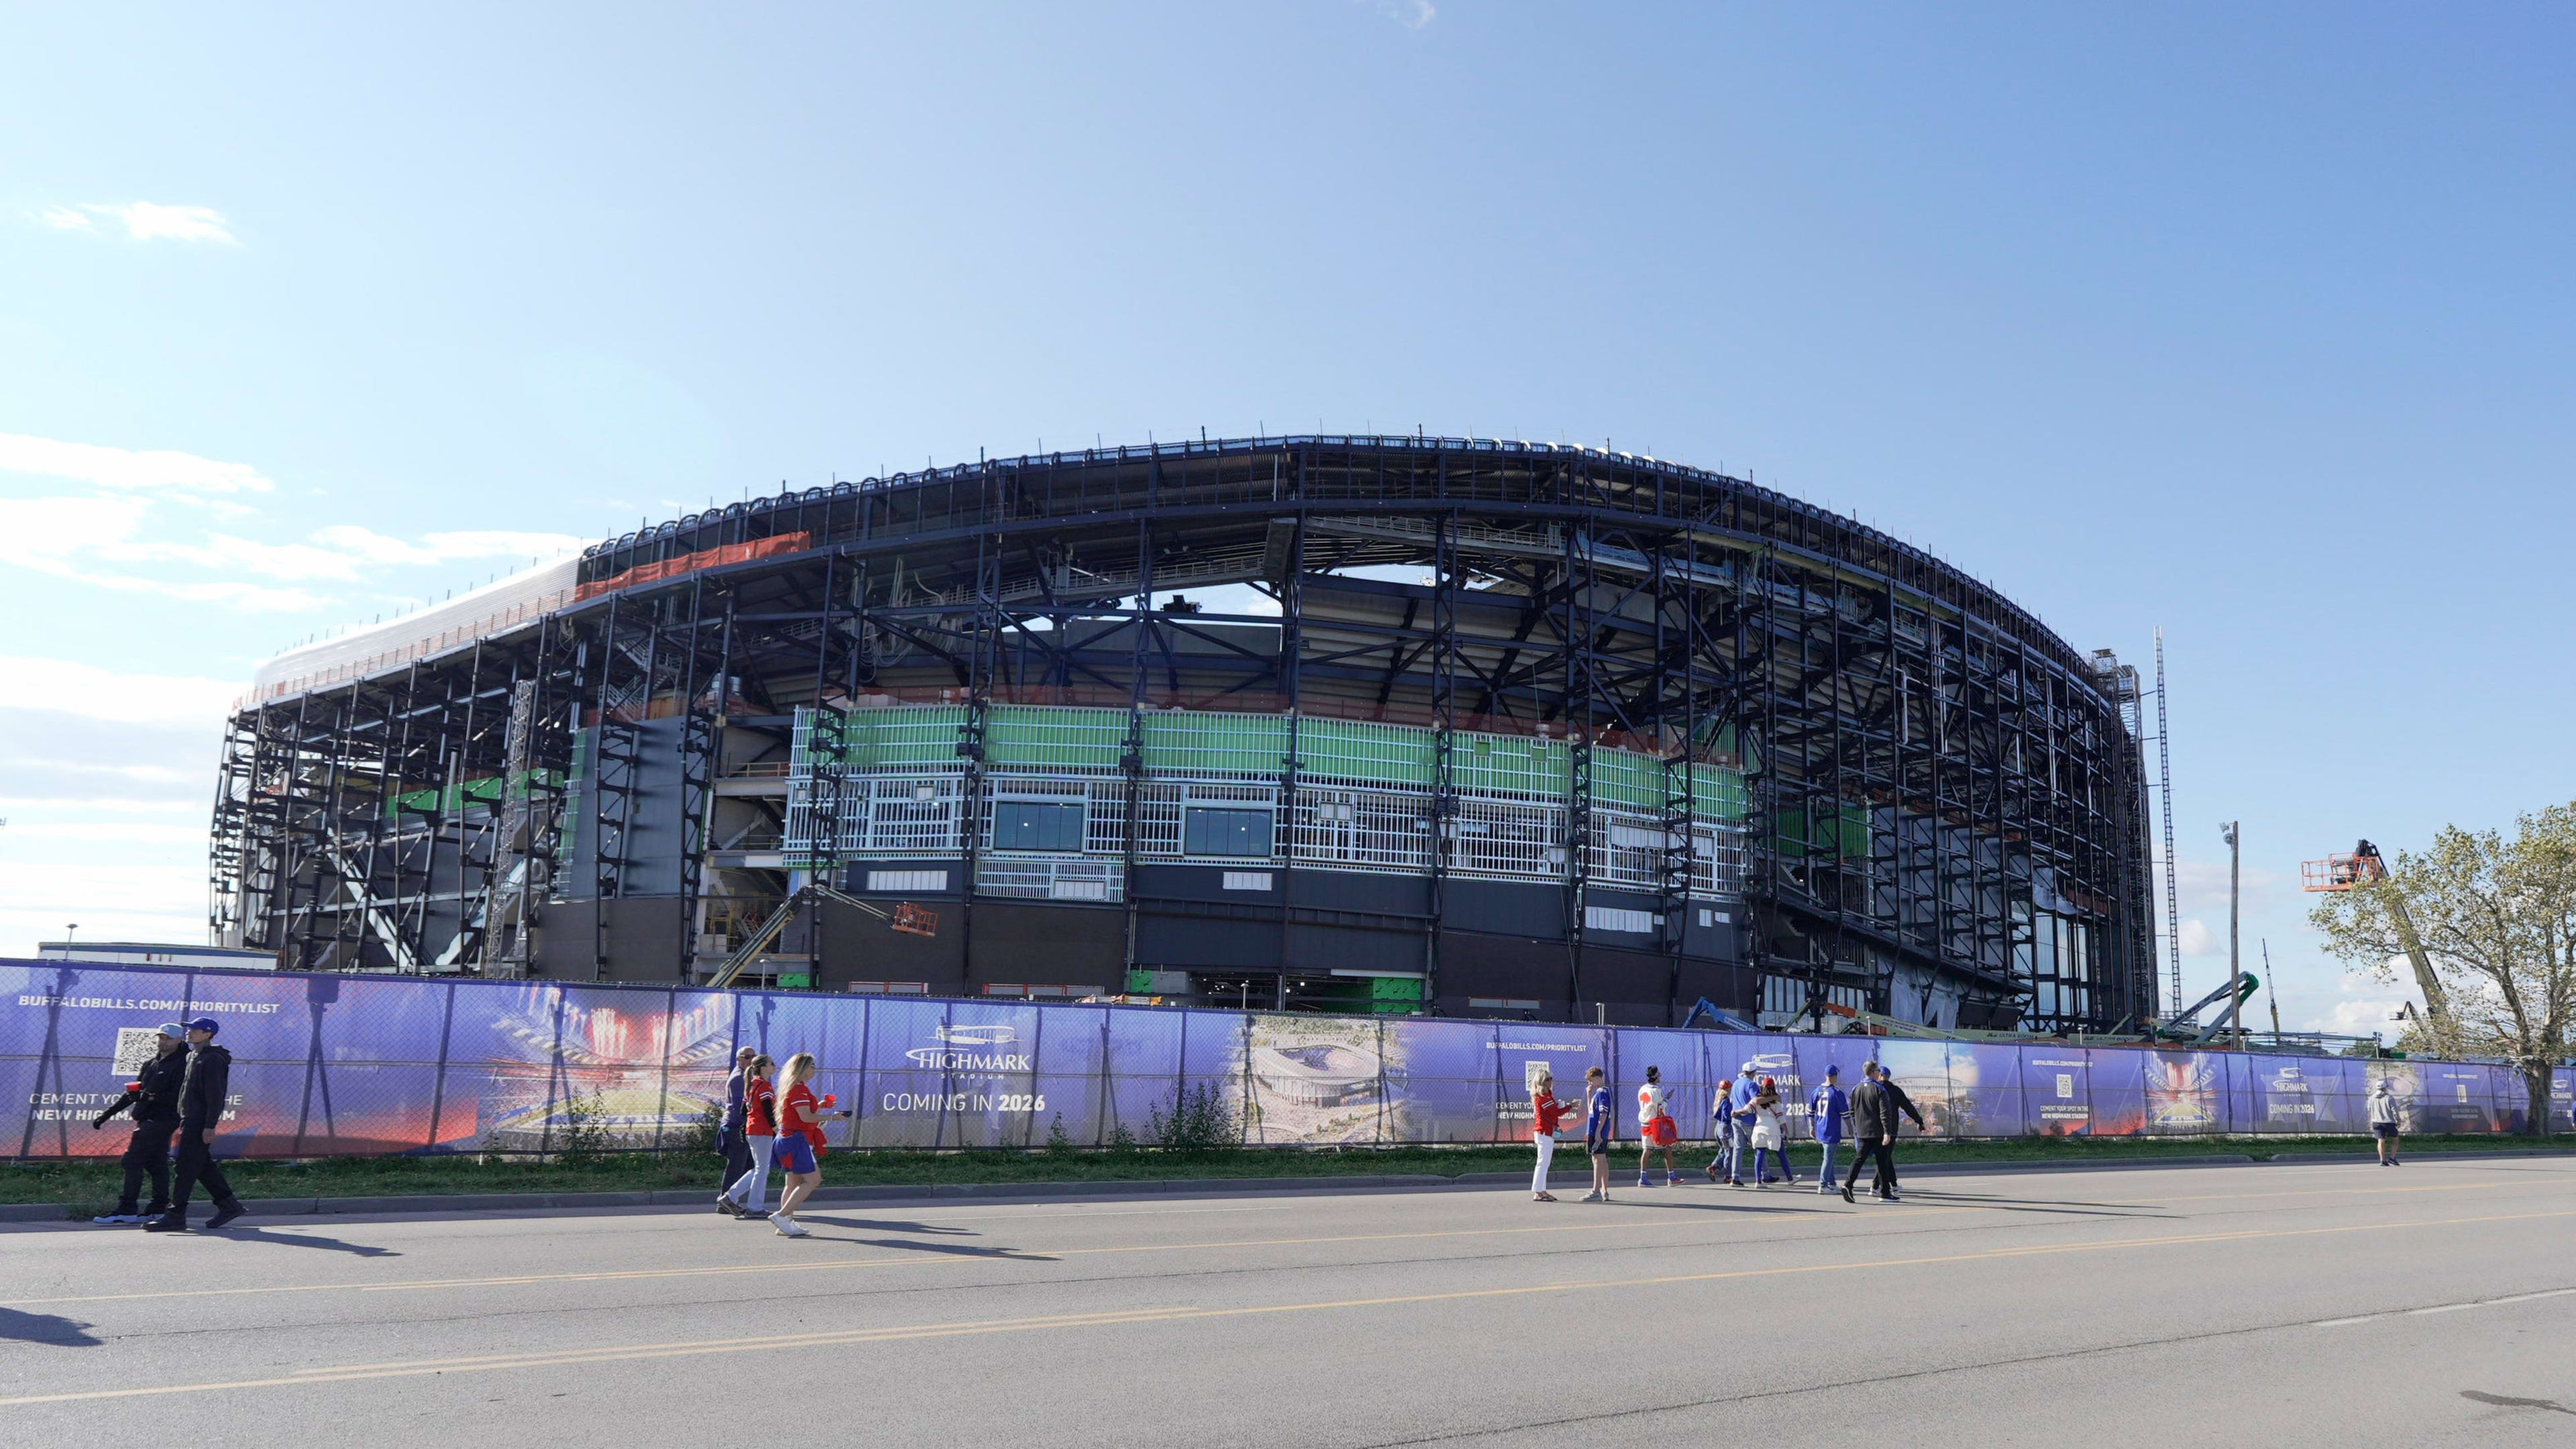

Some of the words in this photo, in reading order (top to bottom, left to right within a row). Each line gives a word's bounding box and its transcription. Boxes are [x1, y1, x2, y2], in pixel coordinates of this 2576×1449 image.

[18, 995, 280, 1014] BUFFALOBILLS.COM/PRIORITYLIST
[1487, 1042, 1587, 1052] BUFFALOBILLS.COM/PRIORITYLIST
[918, 1052, 1030, 1070] HIGHMARK
[2276, 1082, 2308, 1091] HIGHMARK
[30, 1093, 98, 1105] CEMENT
[102, 1094, 121, 1104] YO
[883, 1093, 966, 1111] COMING
[973, 1094, 992, 1111] IN
[998, 1095, 1045, 1112] 2026
[1817, 1100, 1829, 1117] 17
[2269, 1104, 2293, 1114] COMING
[32, 1110, 72, 1120] NEW
